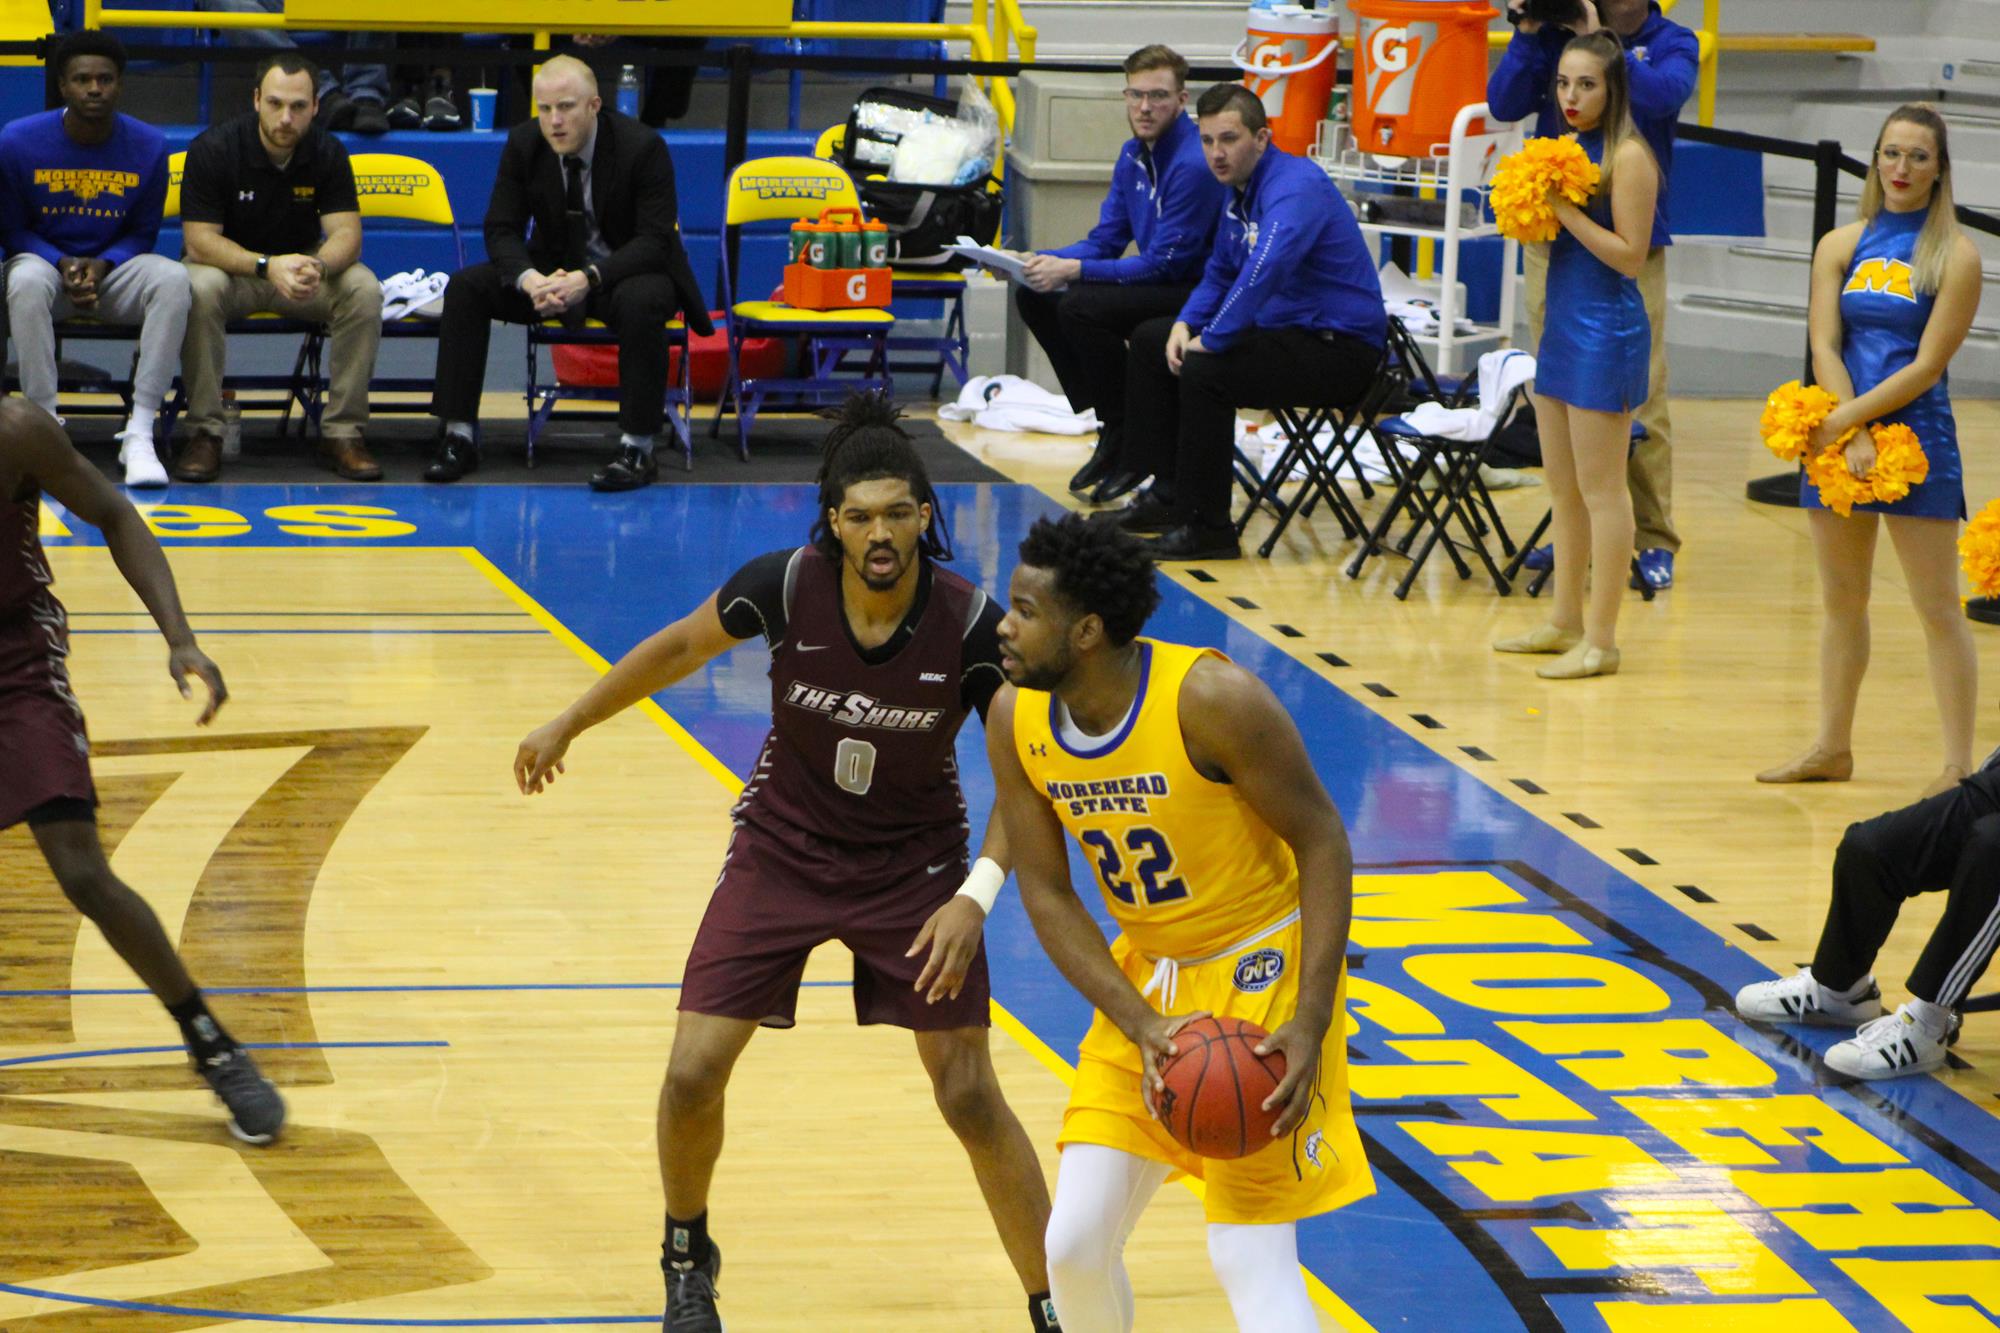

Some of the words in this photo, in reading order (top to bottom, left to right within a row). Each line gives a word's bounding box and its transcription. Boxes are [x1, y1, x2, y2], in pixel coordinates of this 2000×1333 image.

[1372, 28, 1407, 72] G
[34, 169, 139, 188] MOREHEAD
[739, 176, 844, 191] MOREHEAD
[759, 187, 826, 200] STATE
[810, 243, 824, 263] G
[870, 244, 888, 263] G
[847, 274, 866, 302] G
[1843, 257, 1917, 303] M
[919, 672, 947, 682] MEAC
[788, 683, 841, 712] THE
[834, 737, 877, 795] 0
[1046, 773, 1169, 801] MOREHEAD
[1069, 796, 1150, 818] STATE
[1080, 825, 1193, 908] 22
